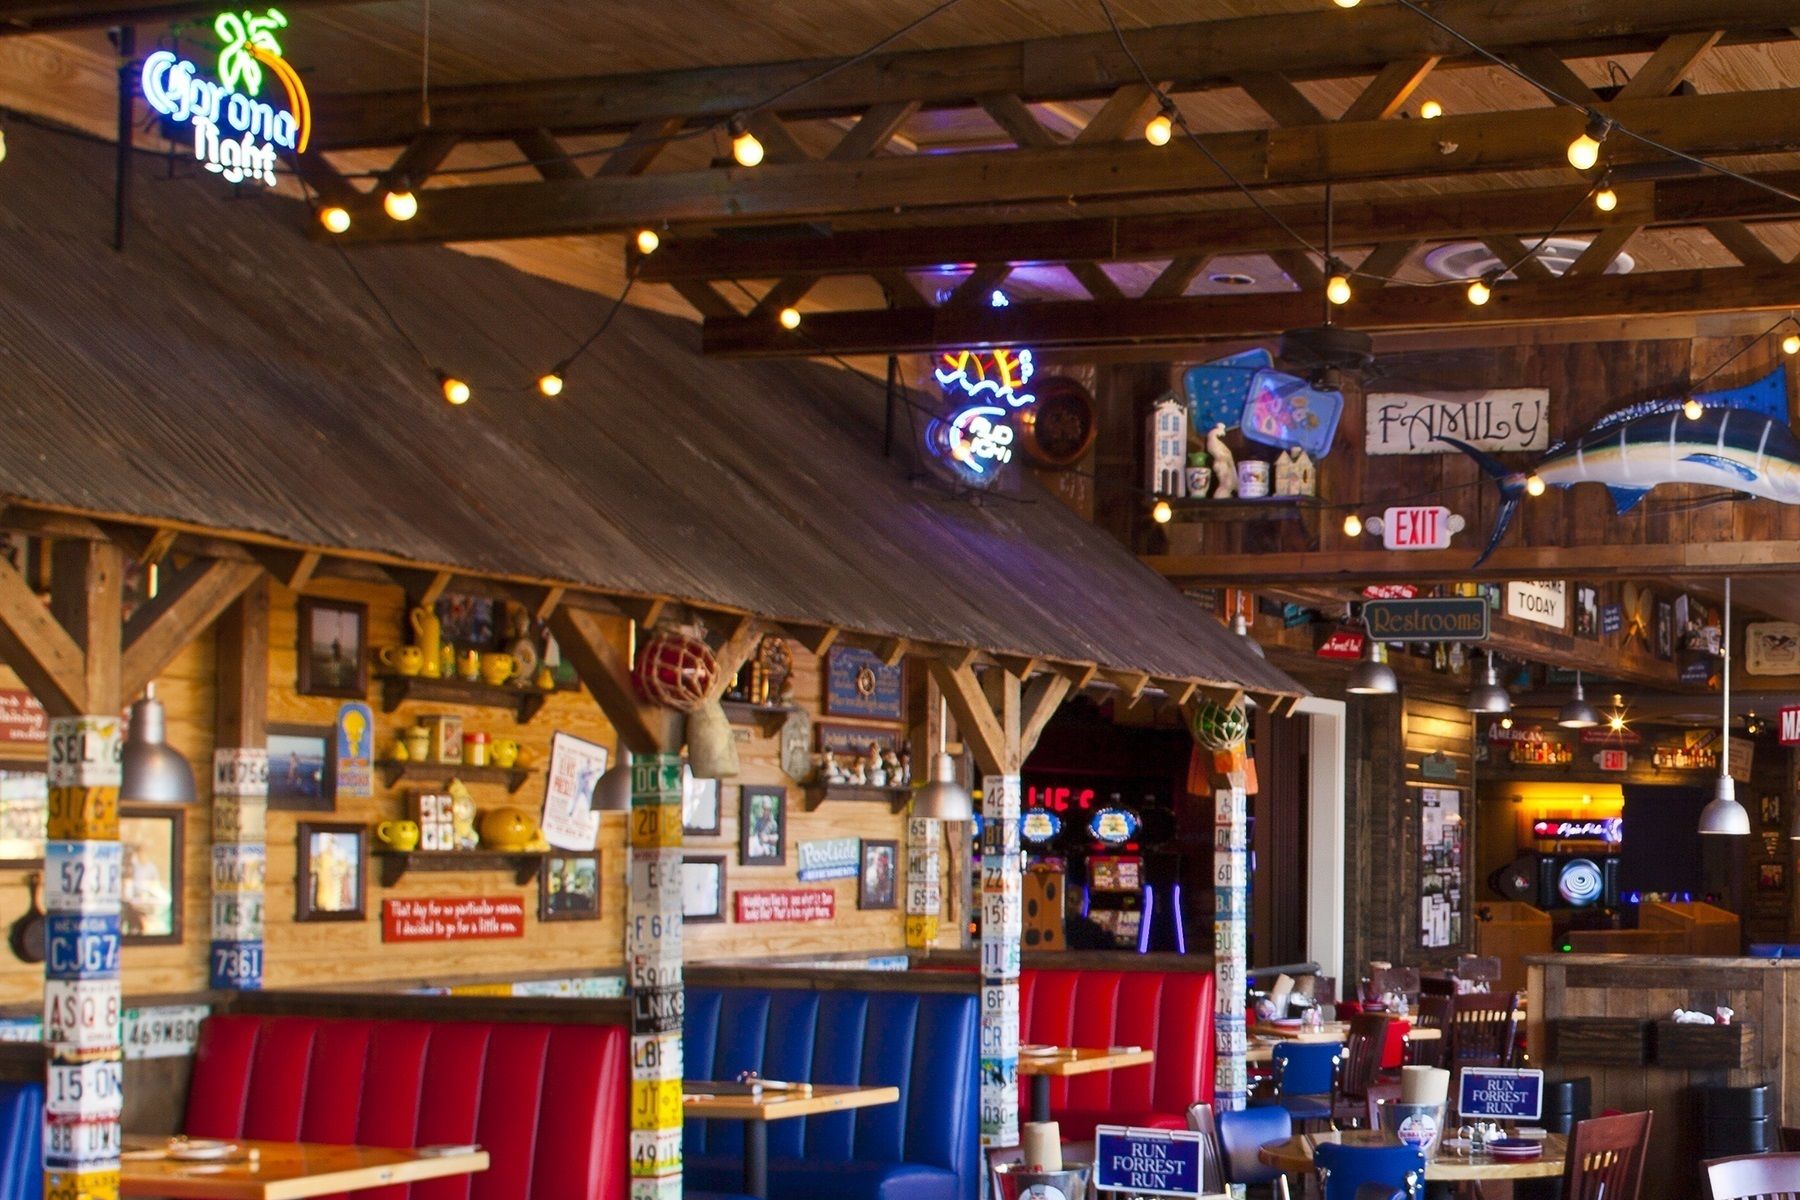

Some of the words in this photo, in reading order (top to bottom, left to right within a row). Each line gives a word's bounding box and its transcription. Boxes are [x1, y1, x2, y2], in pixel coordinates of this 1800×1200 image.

[142, 50, 300, 152] Corona
[1378, 399, 1542, 448] FAMILY
[1396, 510, 1439, 545] EXIT
[1517, 591, 1557, 617] TODAY
[1373, 607, 1482, 633] Restrooms
[803, 839, 858, 864] Poolside
[412, 901, 427, 921] day
[428, 901, 442, 917] for
[455, 899, 494, 920] particular
[402, 919, 435, 936] decided
[435, 919, 445, 935] to
[446, 923, 456, 940] go
[457, 918, 470, 934] for
[479, 916, 499, 933] little
[1472, 1089, 1529, 1103] FORREST
[1487, 1079, 1515, 1091] RUN
[1486, 1101, 1513, 1114] RUN
[1130, 1142, 1167, 1160] RUN
[1112, 1155, 1186, 1176] FORREST
[1130, 1171, 1167, 1189] RUN
